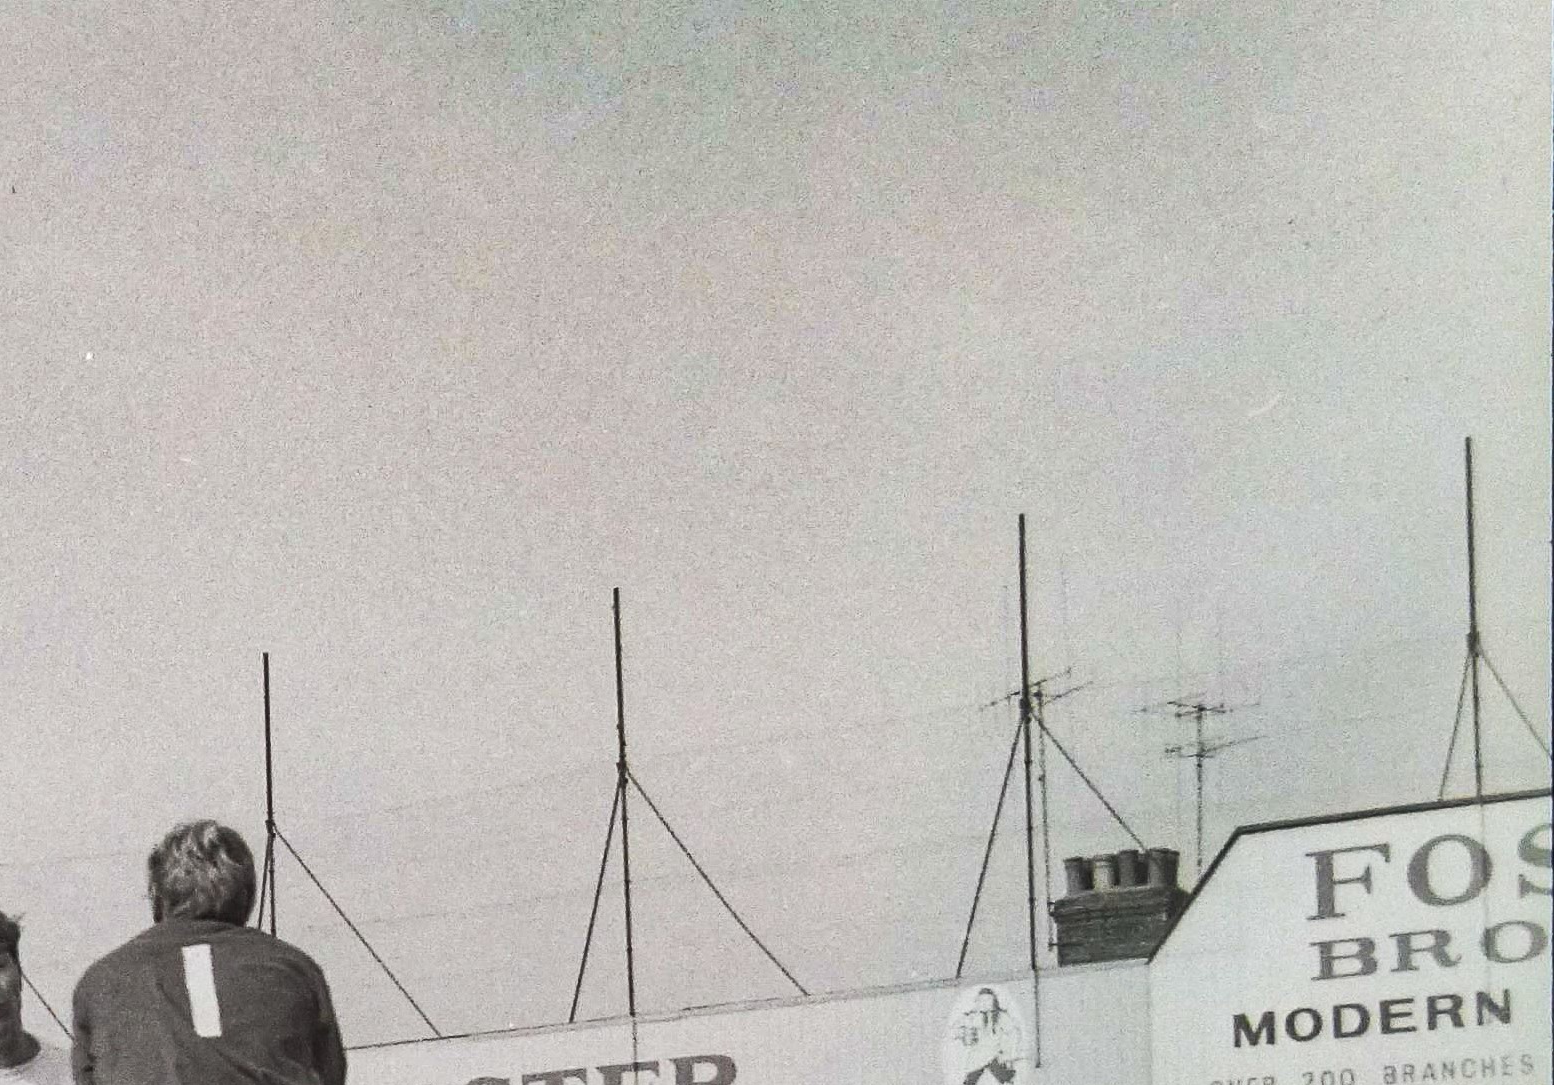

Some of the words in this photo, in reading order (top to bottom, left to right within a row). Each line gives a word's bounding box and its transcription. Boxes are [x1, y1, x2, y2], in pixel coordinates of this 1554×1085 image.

[1309, 920, 1548, 981] BRO
[182, 943, 222, 1038] 1
[1232, 988, 1513, 1048] MODERN
